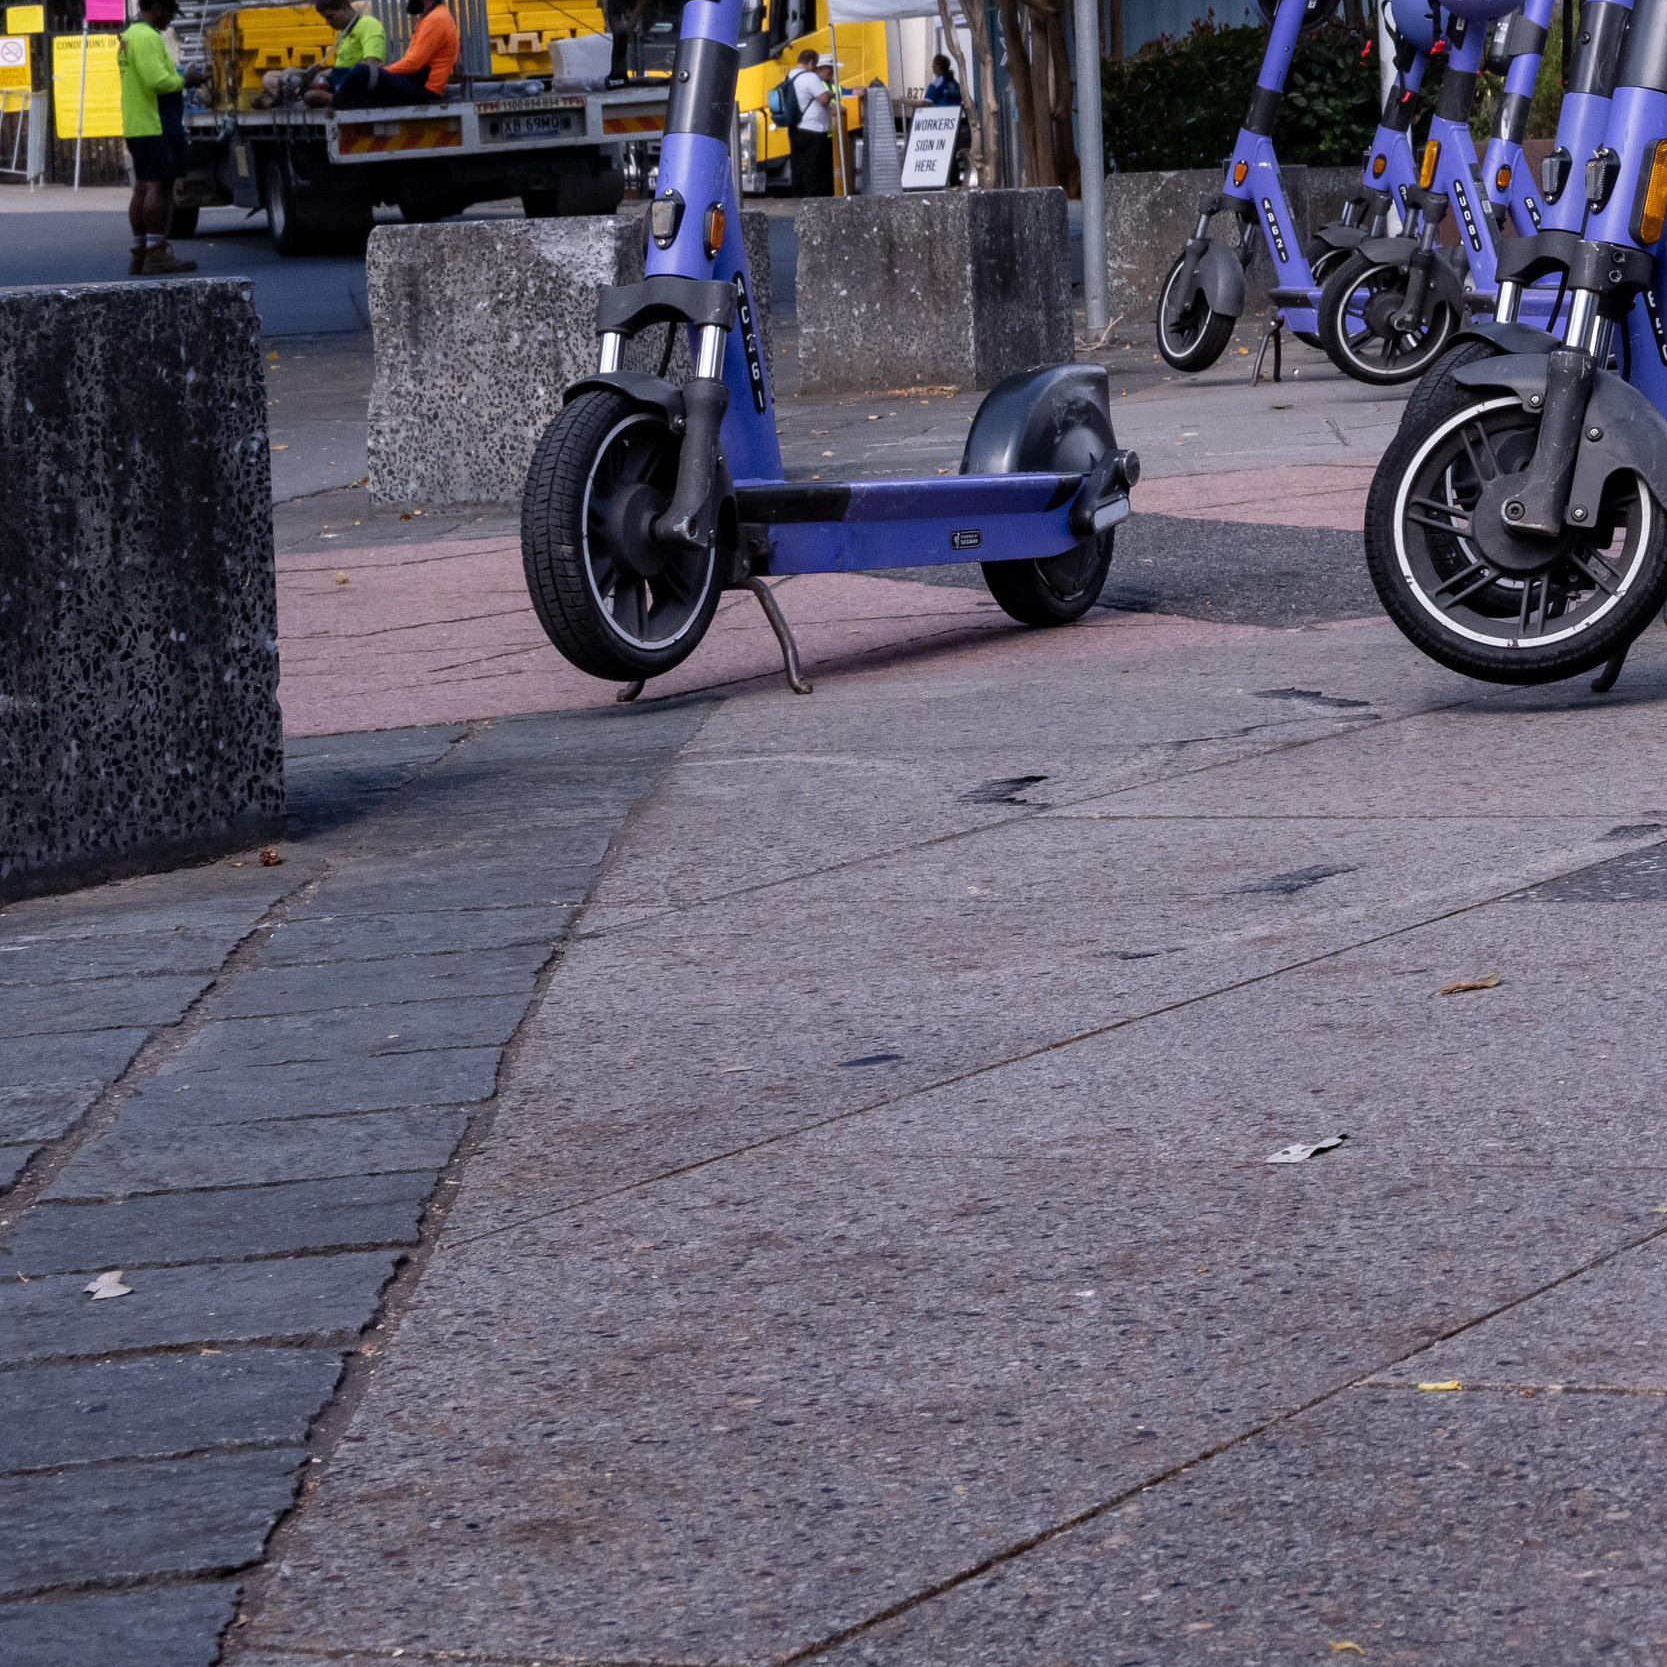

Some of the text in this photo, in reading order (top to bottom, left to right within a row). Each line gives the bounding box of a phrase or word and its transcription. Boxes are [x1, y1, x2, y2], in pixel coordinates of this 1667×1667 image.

[56, 38, 105, 50] CONDIIONS
[907, 87, 924, 99] 827
[914, 118, 956, 131] WORKERS
[914, 139, 946, 152] SIGN IN
[914, 159, 938, 172] HERE
